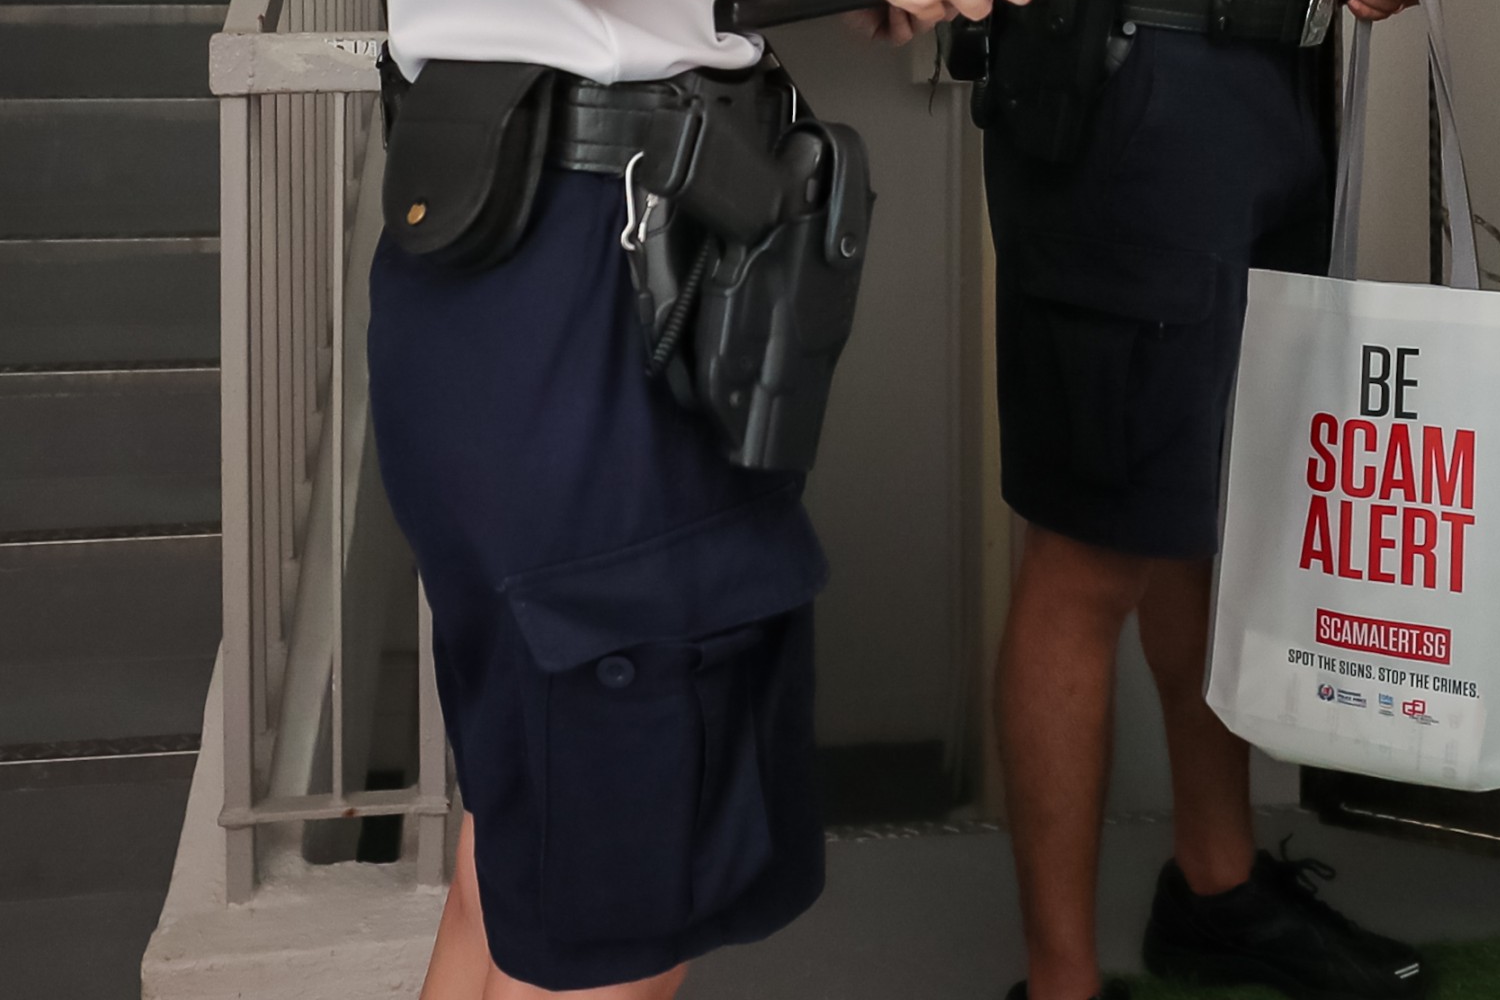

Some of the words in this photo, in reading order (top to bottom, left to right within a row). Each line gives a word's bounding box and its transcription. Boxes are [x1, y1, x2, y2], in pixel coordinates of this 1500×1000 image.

[1360, 345, 1420, 420] BE
[1306, 412, 1475, 509] SCAM
[1299, 494, 1475, 593] ALERT
[1288, 649, 1315, 666] SPOT
[1318, 654, 1336, 672] THE
[1339, 659, 1375, 680] SIGNS.
[1378, 667, 1406, 686] STOP
[1409, 672, 1430, 691] THE
[1433, 676, 1480, 699] CRIMES.
[1320, 614, 1446, 659] SCAMALERT.SG
